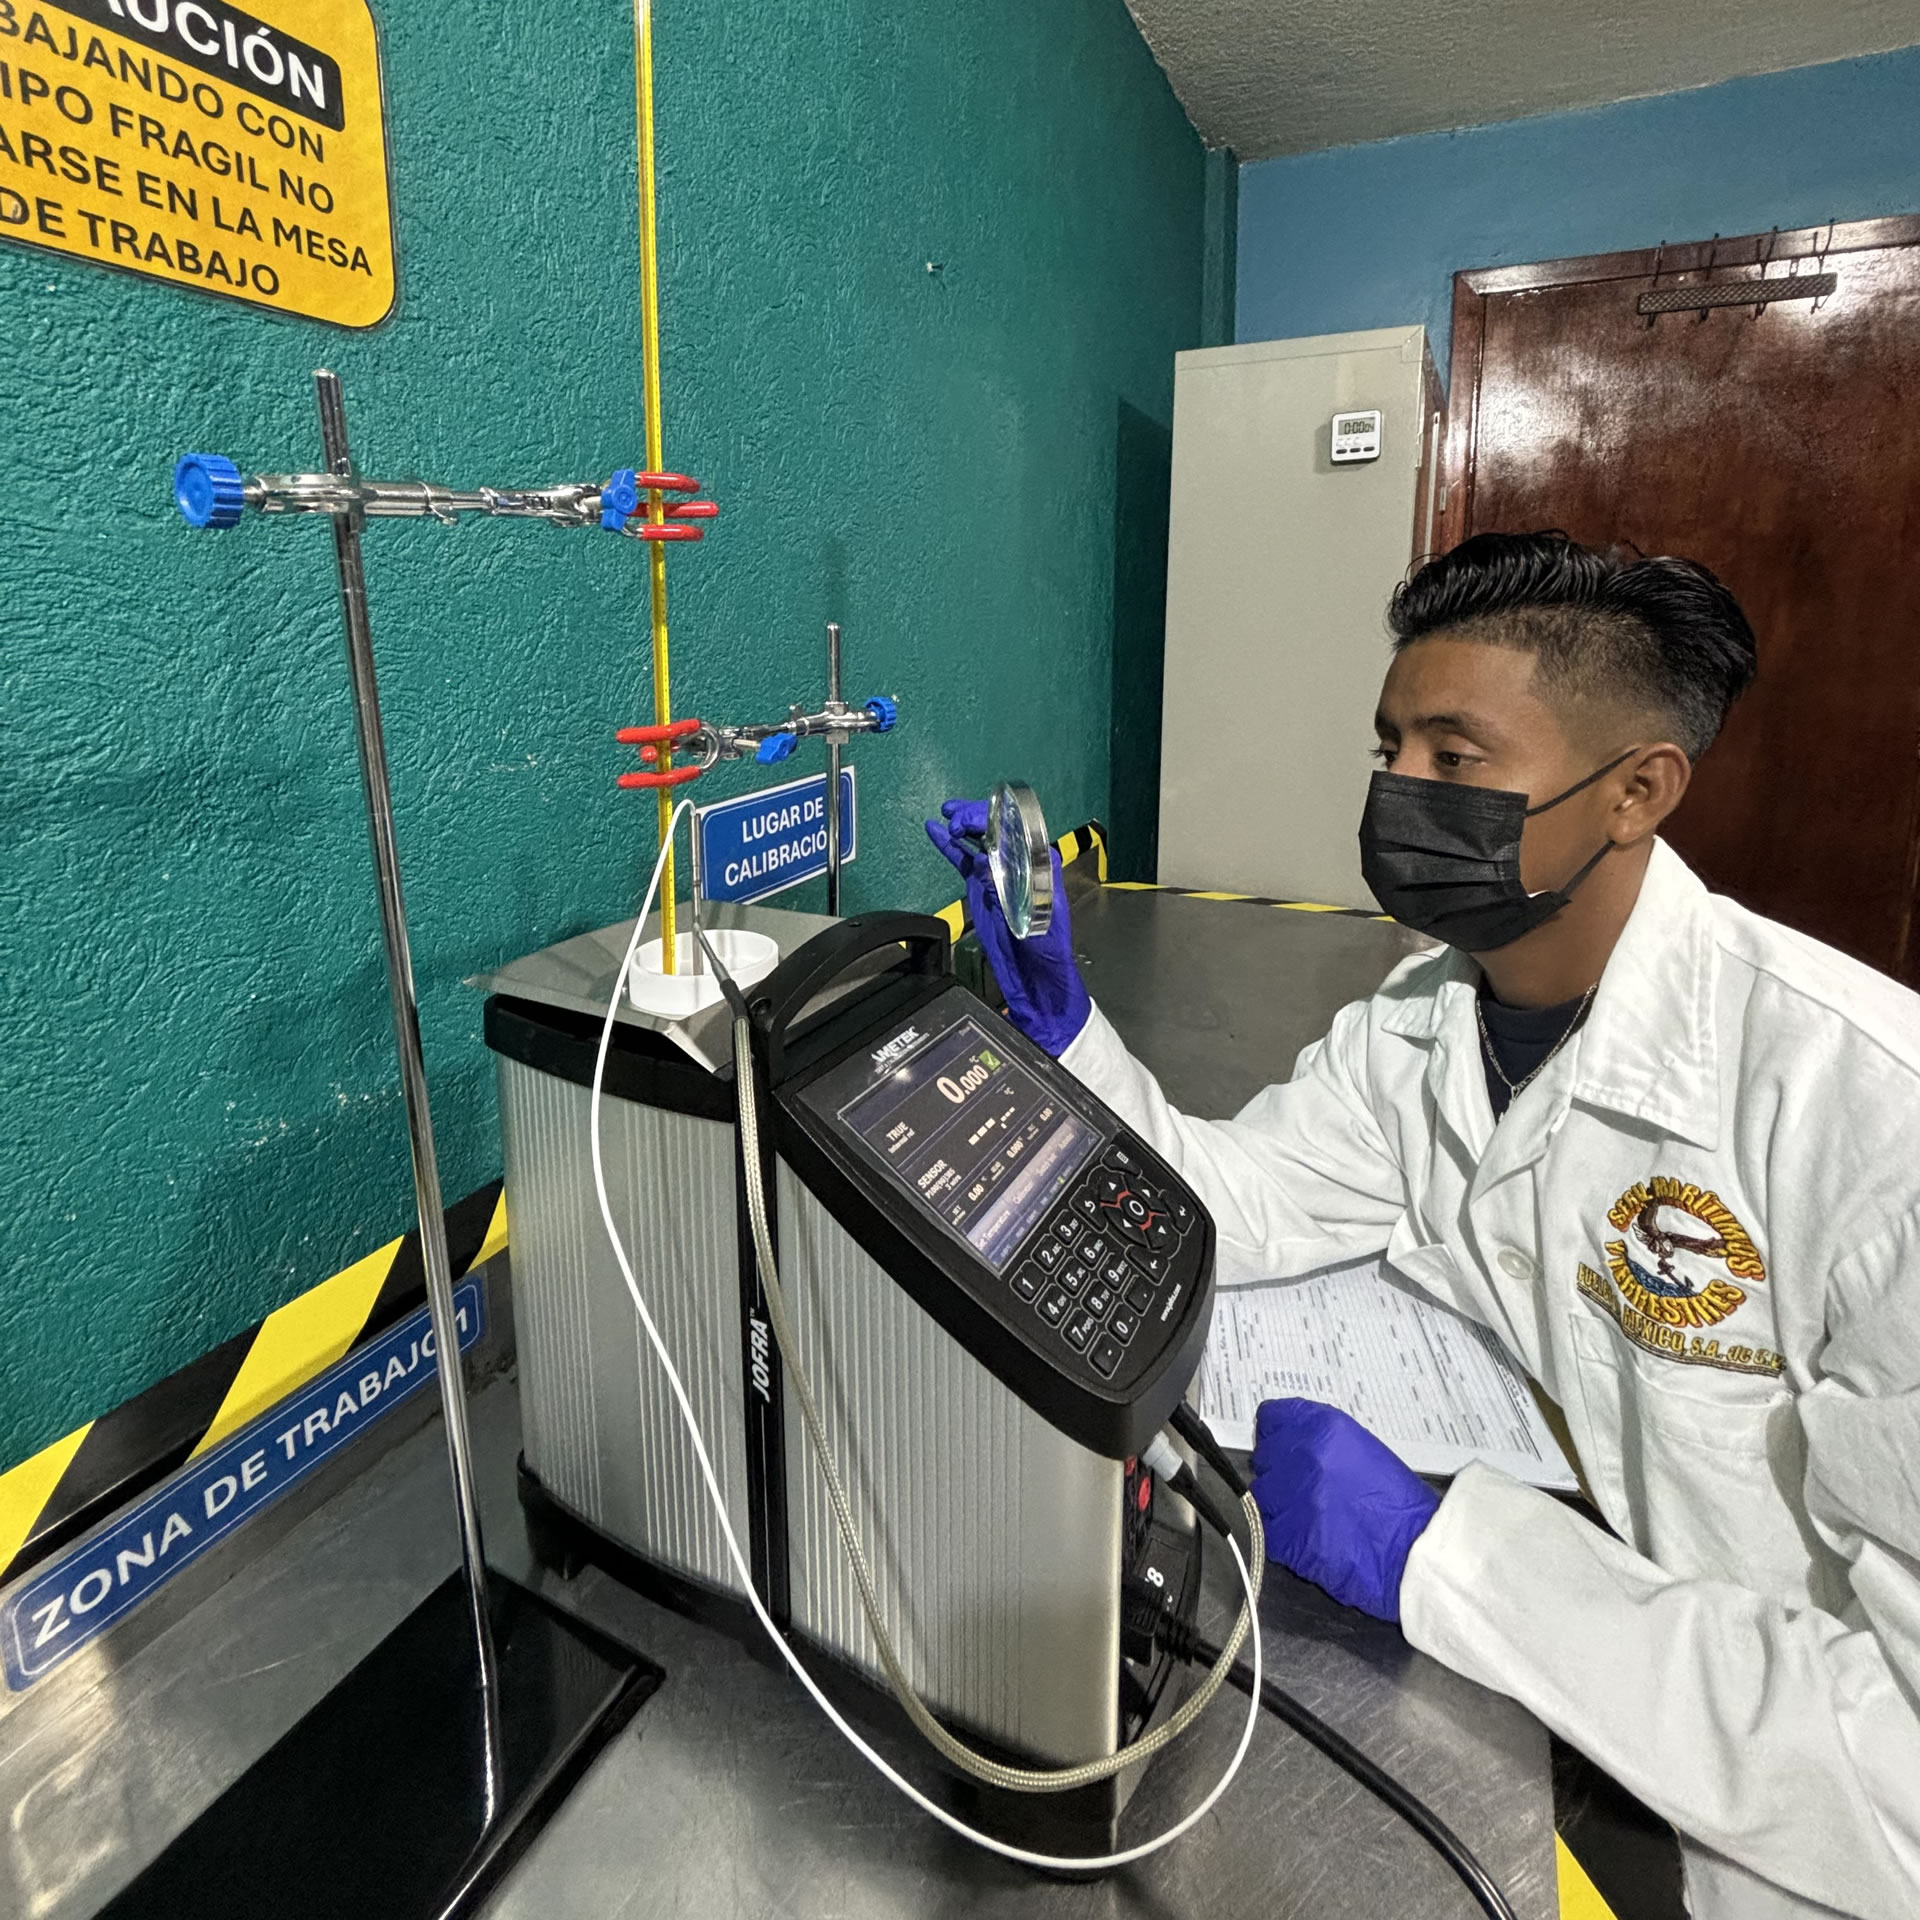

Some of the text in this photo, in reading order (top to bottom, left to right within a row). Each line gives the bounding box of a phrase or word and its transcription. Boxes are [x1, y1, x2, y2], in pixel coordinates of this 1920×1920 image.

[108, 0, 326, 109] UCIÓN
[237, 102, 324, 163] CON
[110, 103, 269, 192] FRAGIL
[280, 169, 334, 214] NO
[137, 170, 198, 220] EN
[212, 196, 264, 242] LA
[273, 217, 373, 276] MESA
[0, 186, 280, 295] DE TRABAJO
[742, 797, 824, 843] LUGAR DE
[724, 825, 828, 887] CALIBRACIÓ
[937, 1065, 989, 1103] 0.000
[886, 1121, 908, 1141] TRUE
[918, 1160, 947, 1189] SENSOR
[968, 1184, 984, 1201] 0.00
[1060, 1225, 1072, 1237] 3
[1041, 1243, 1062, 1264] 2 ABC
[1084, 1247, 1096, 1259] 6
[1022, 1277, 1034, 1290] 1
[1065, 1273, 1078, 1286] 5
[1108, 1269, 1120, 1282] 9
[1091, 1297, 1103, 1310] 8
[1607, 1257, 1747, 1328] TERRESTRES
[1047, 1302, 1060, 1315] 4
[1071, 1326, 1084, 1341] 7
[1116, 1321, 1129, 1334] 0
[750, 1318, 770, 1402] JOFRA
[32, 1306, 467, 1648] ZONA DE TRABAJO 1
